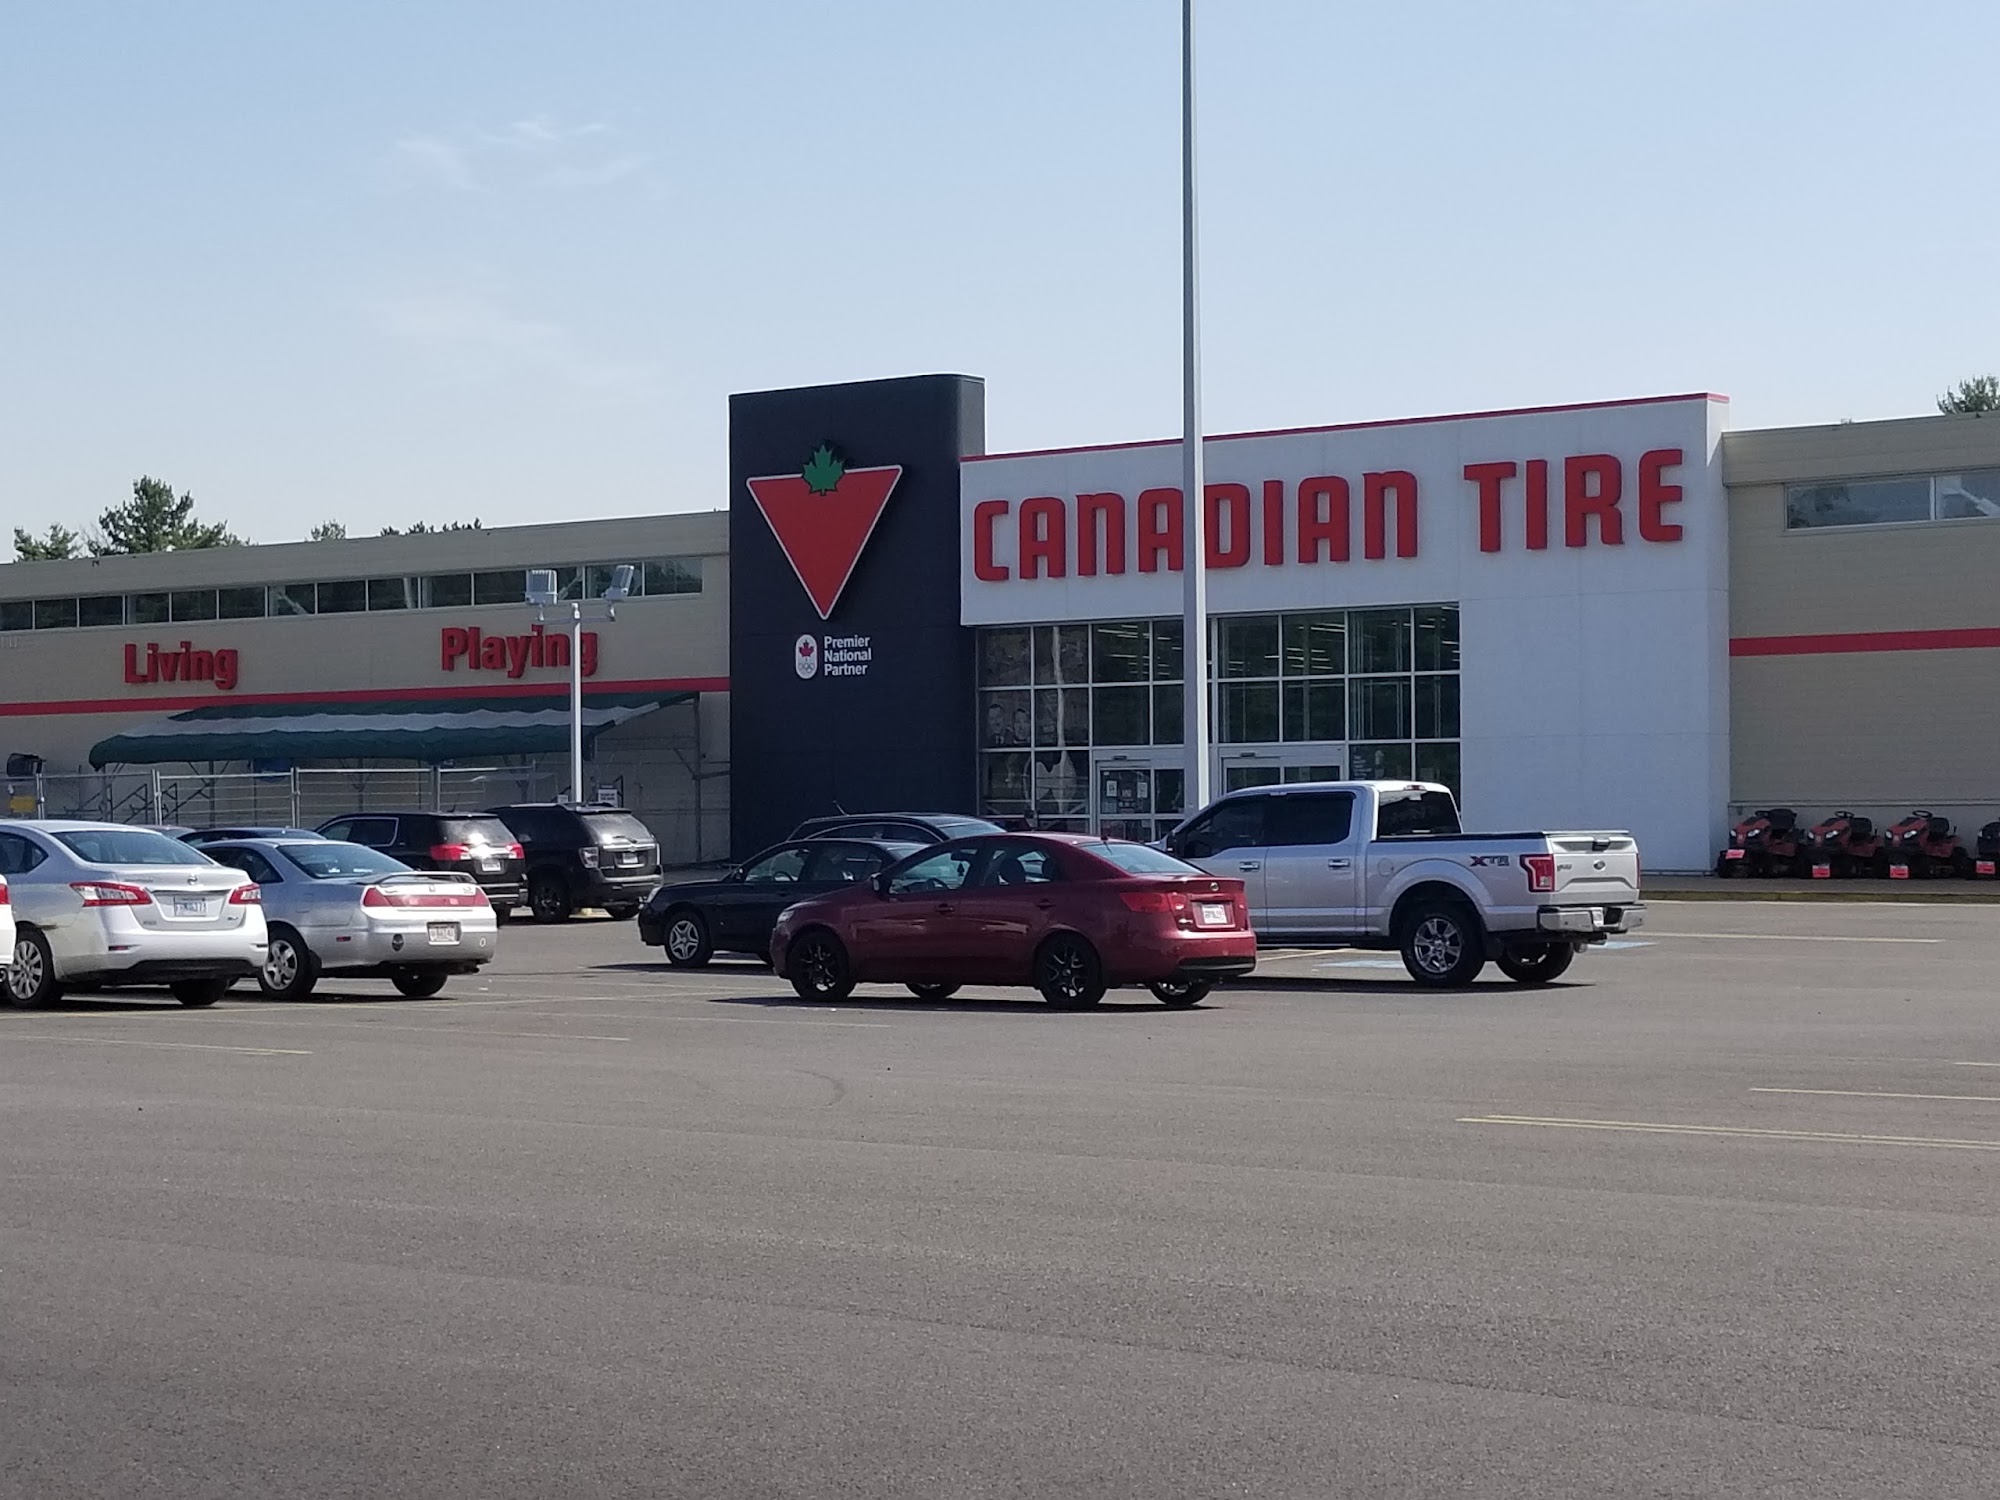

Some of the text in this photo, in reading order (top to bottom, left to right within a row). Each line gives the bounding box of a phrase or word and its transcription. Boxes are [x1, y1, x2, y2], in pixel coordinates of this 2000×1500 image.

[973, 448, 1684, 582] CANADIAN TIRE
[441, 623, 599, 680] Playing
[823, 634, 871, 649] Premier
[824, 647, 872, 663] National
[124, 640, 239, 690] Living
[824, 663, 868, 676] Partner
